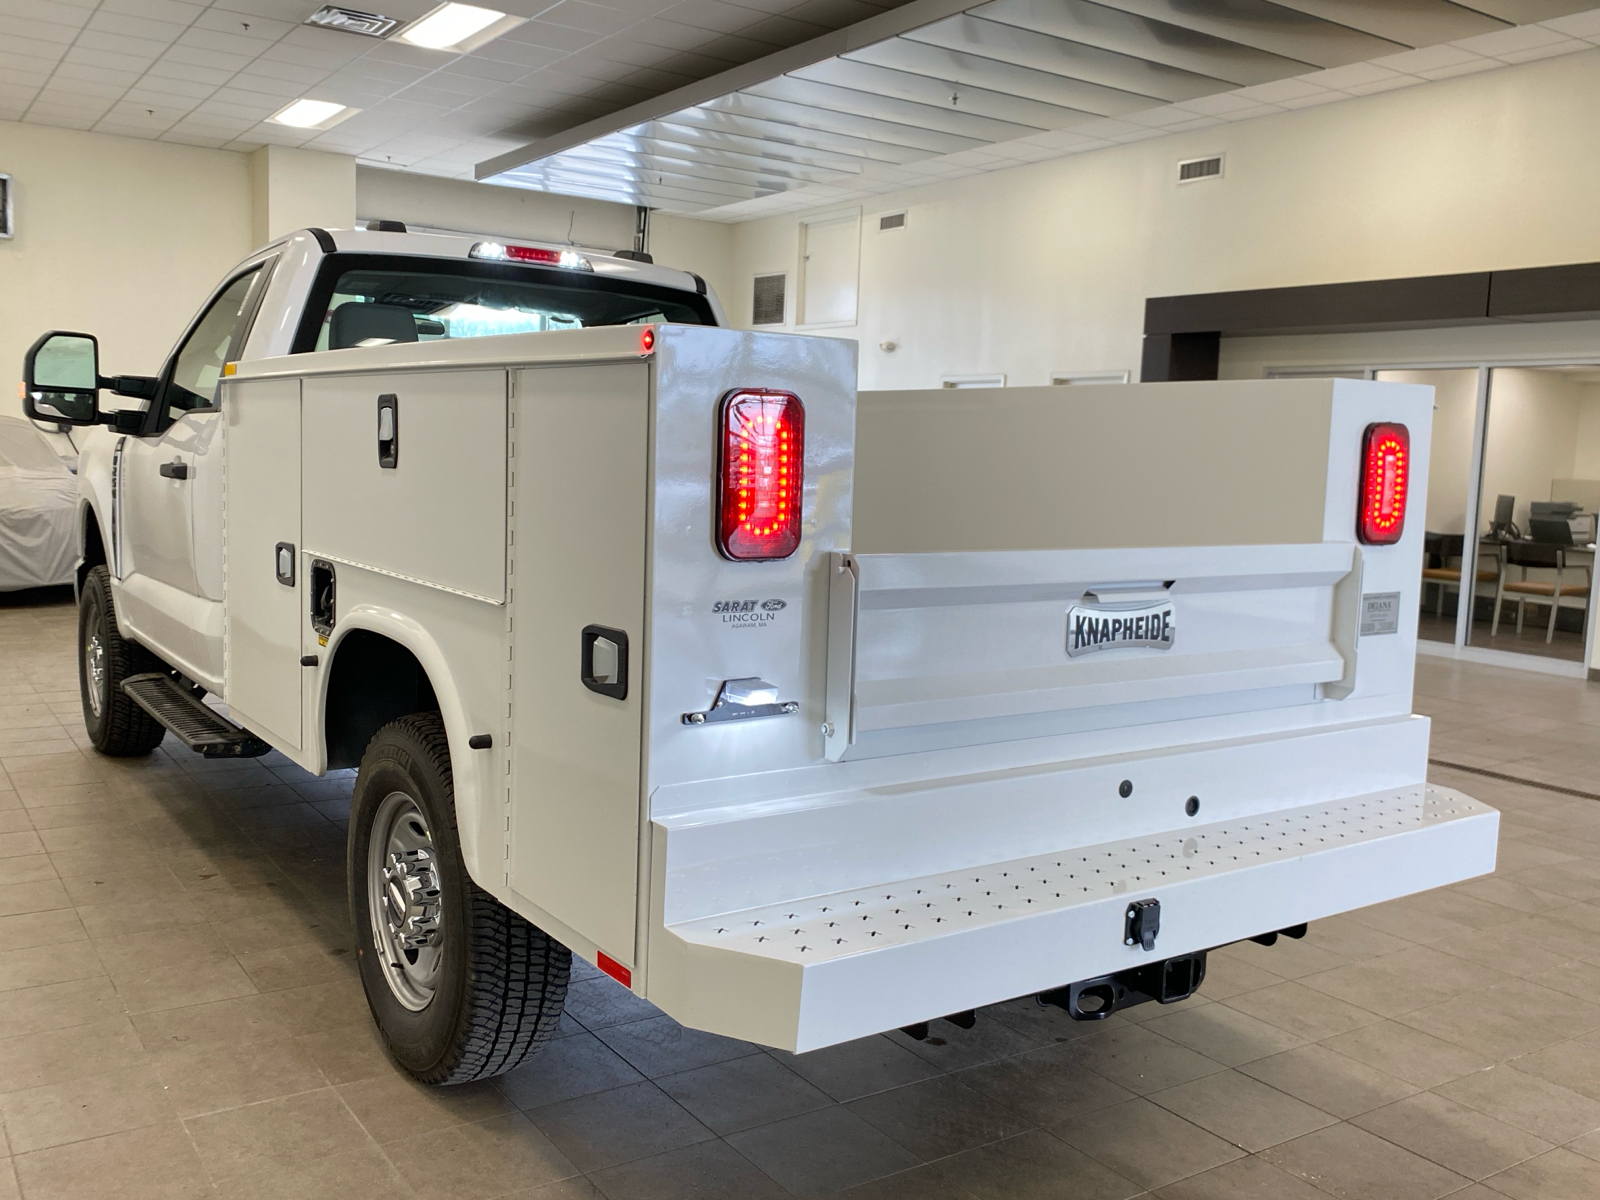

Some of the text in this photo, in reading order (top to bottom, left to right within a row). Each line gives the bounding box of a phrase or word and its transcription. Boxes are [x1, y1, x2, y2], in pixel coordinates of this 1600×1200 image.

[712, 600, 759, 613] SARAT
[722, 613, 775, 623] LINCOLN
[1074, 610, 1172, 649] KNAPHEIDE
